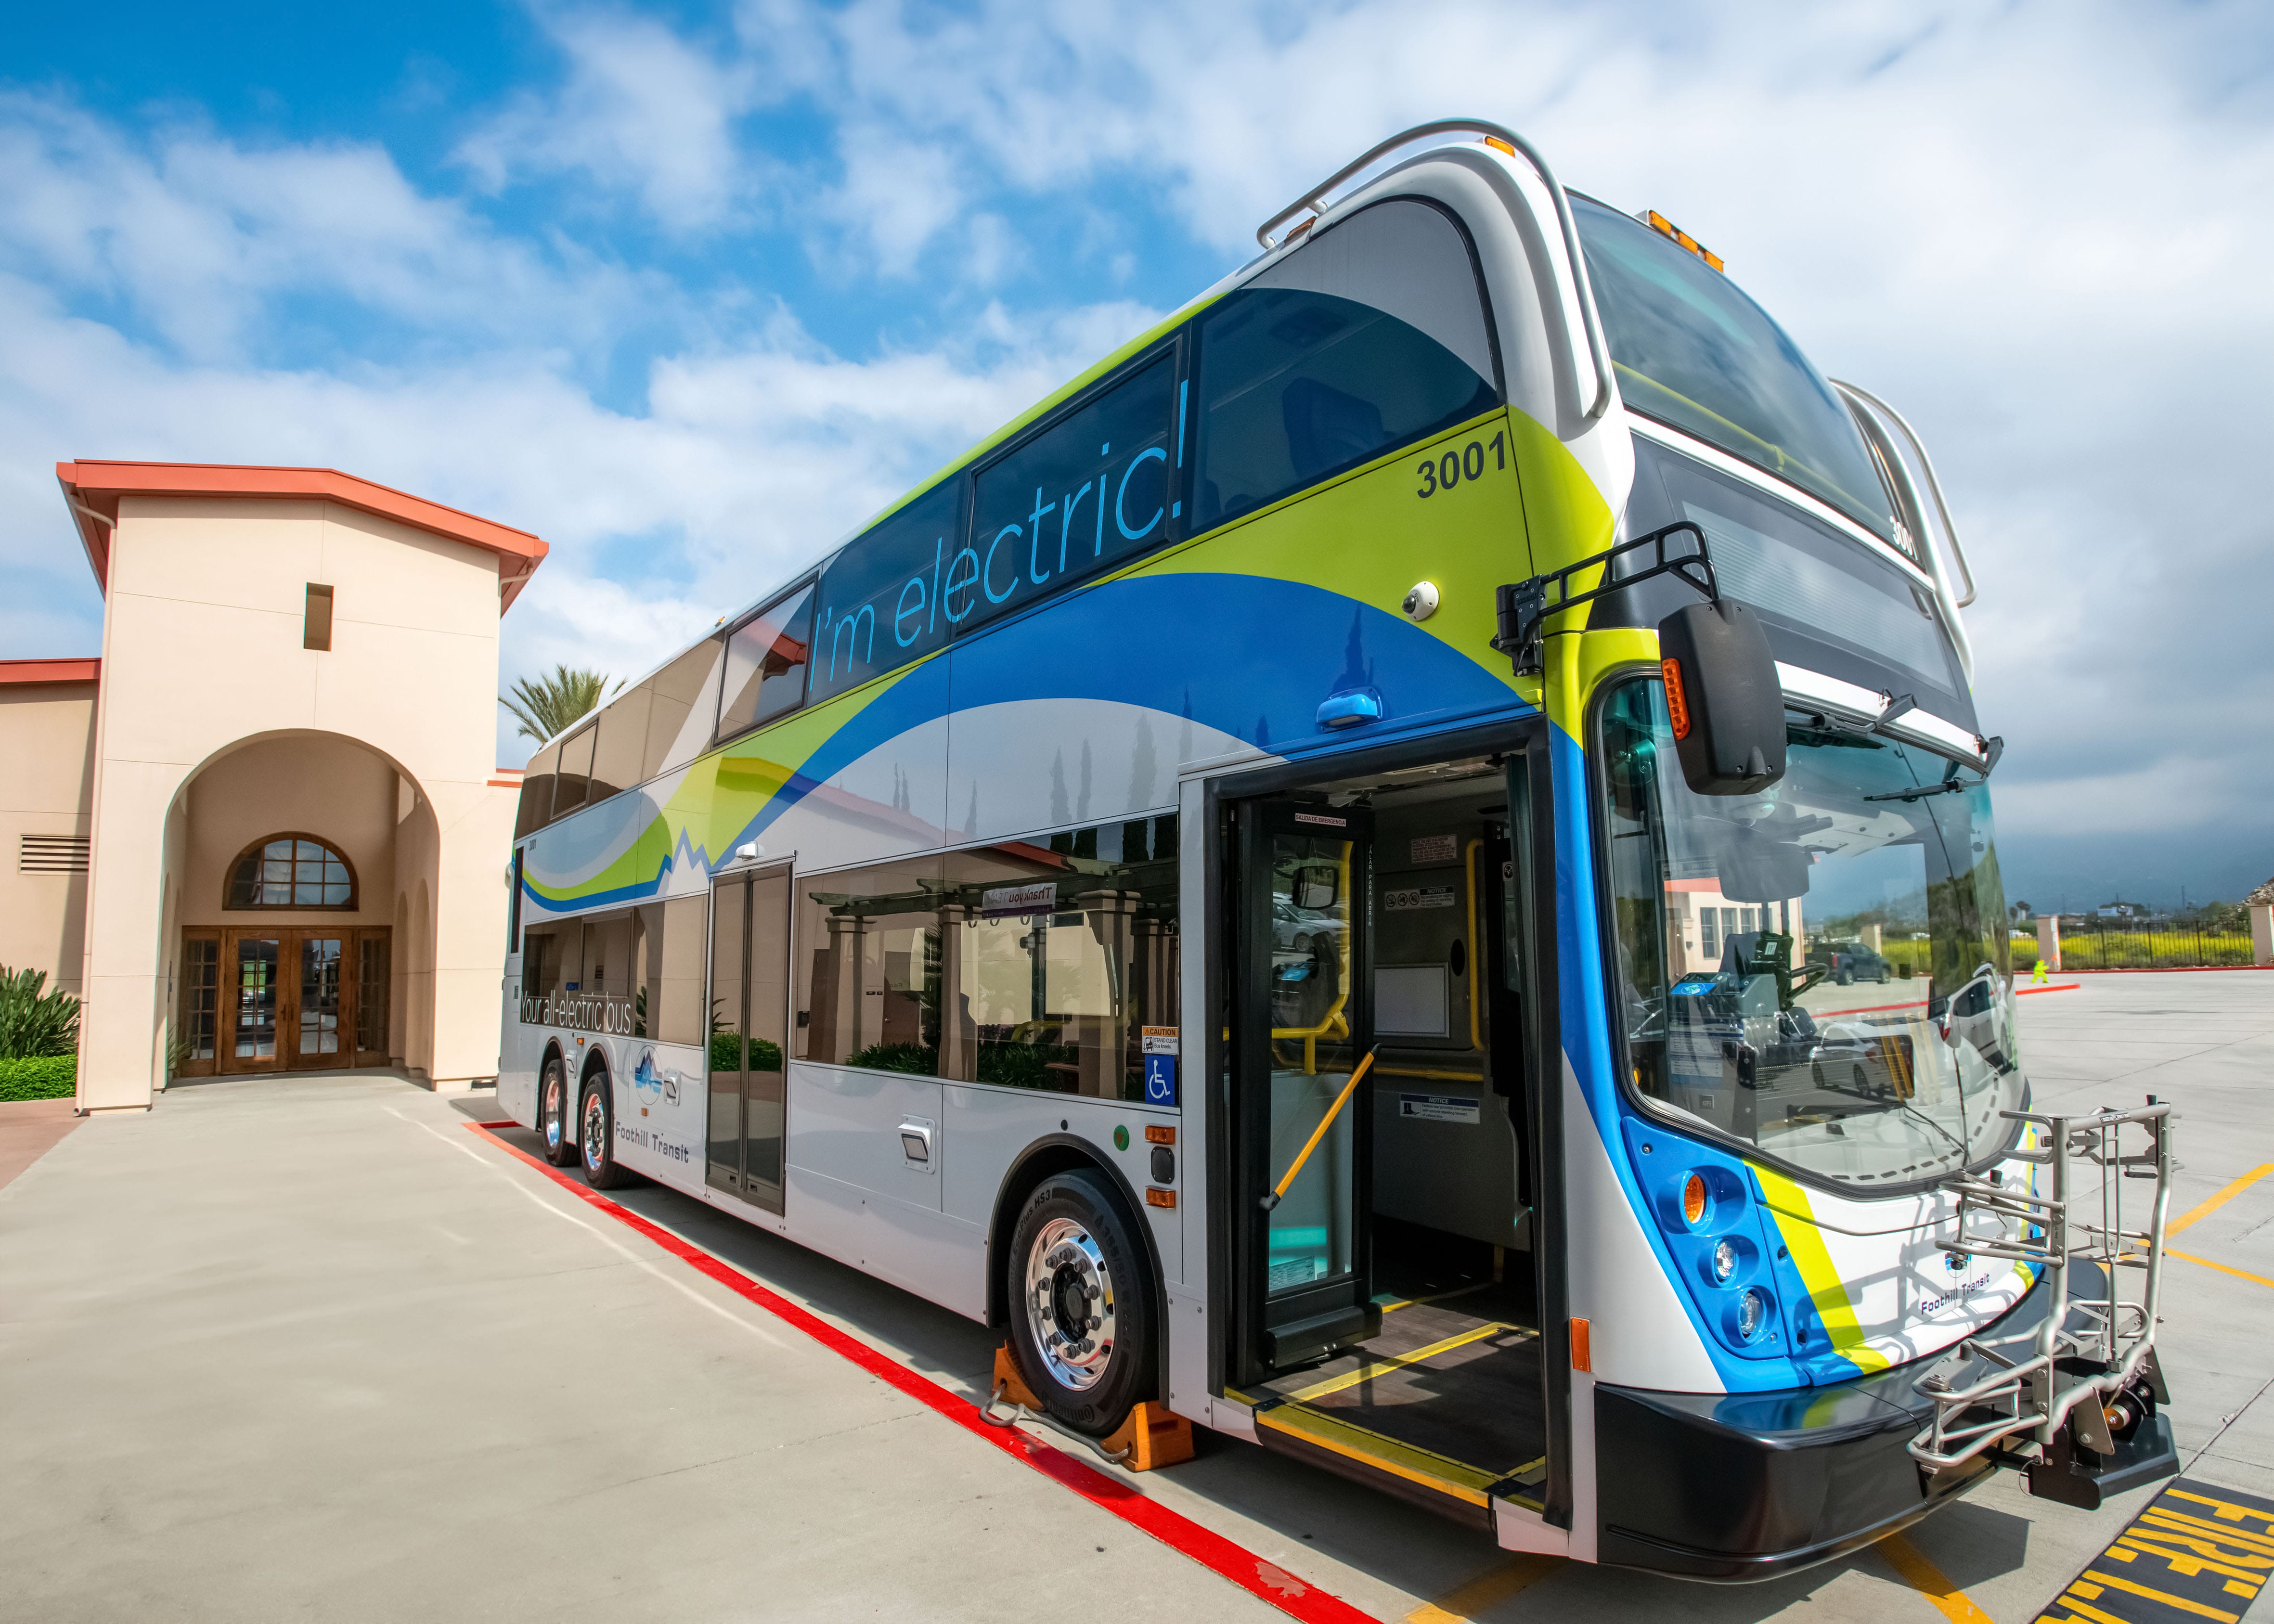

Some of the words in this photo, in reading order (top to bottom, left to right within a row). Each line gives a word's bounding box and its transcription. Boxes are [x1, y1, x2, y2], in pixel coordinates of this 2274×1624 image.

[1417, 430, 1505, 498] 3001
[809, 606, 875, 692] I'm
[894, 379, 1189, 648] electric!
[1889, 516, 1918, 561] 3001
[521, 990, 542, 1022] Your
[543, 990, 602, 1031] all-electric
[606, 991, 631, 1034] bus
[616, 1121, 648, 1147] Foothill
[652, 1134, 689, 1163] Transit
[1033, 1187, 1052, 1210] HS3
[1921, 1287, 1958, 1315] Foothill
[1962, 1273, 1990, 1296] Transit
[2104, 1488, 2274, 1599] FIRE
